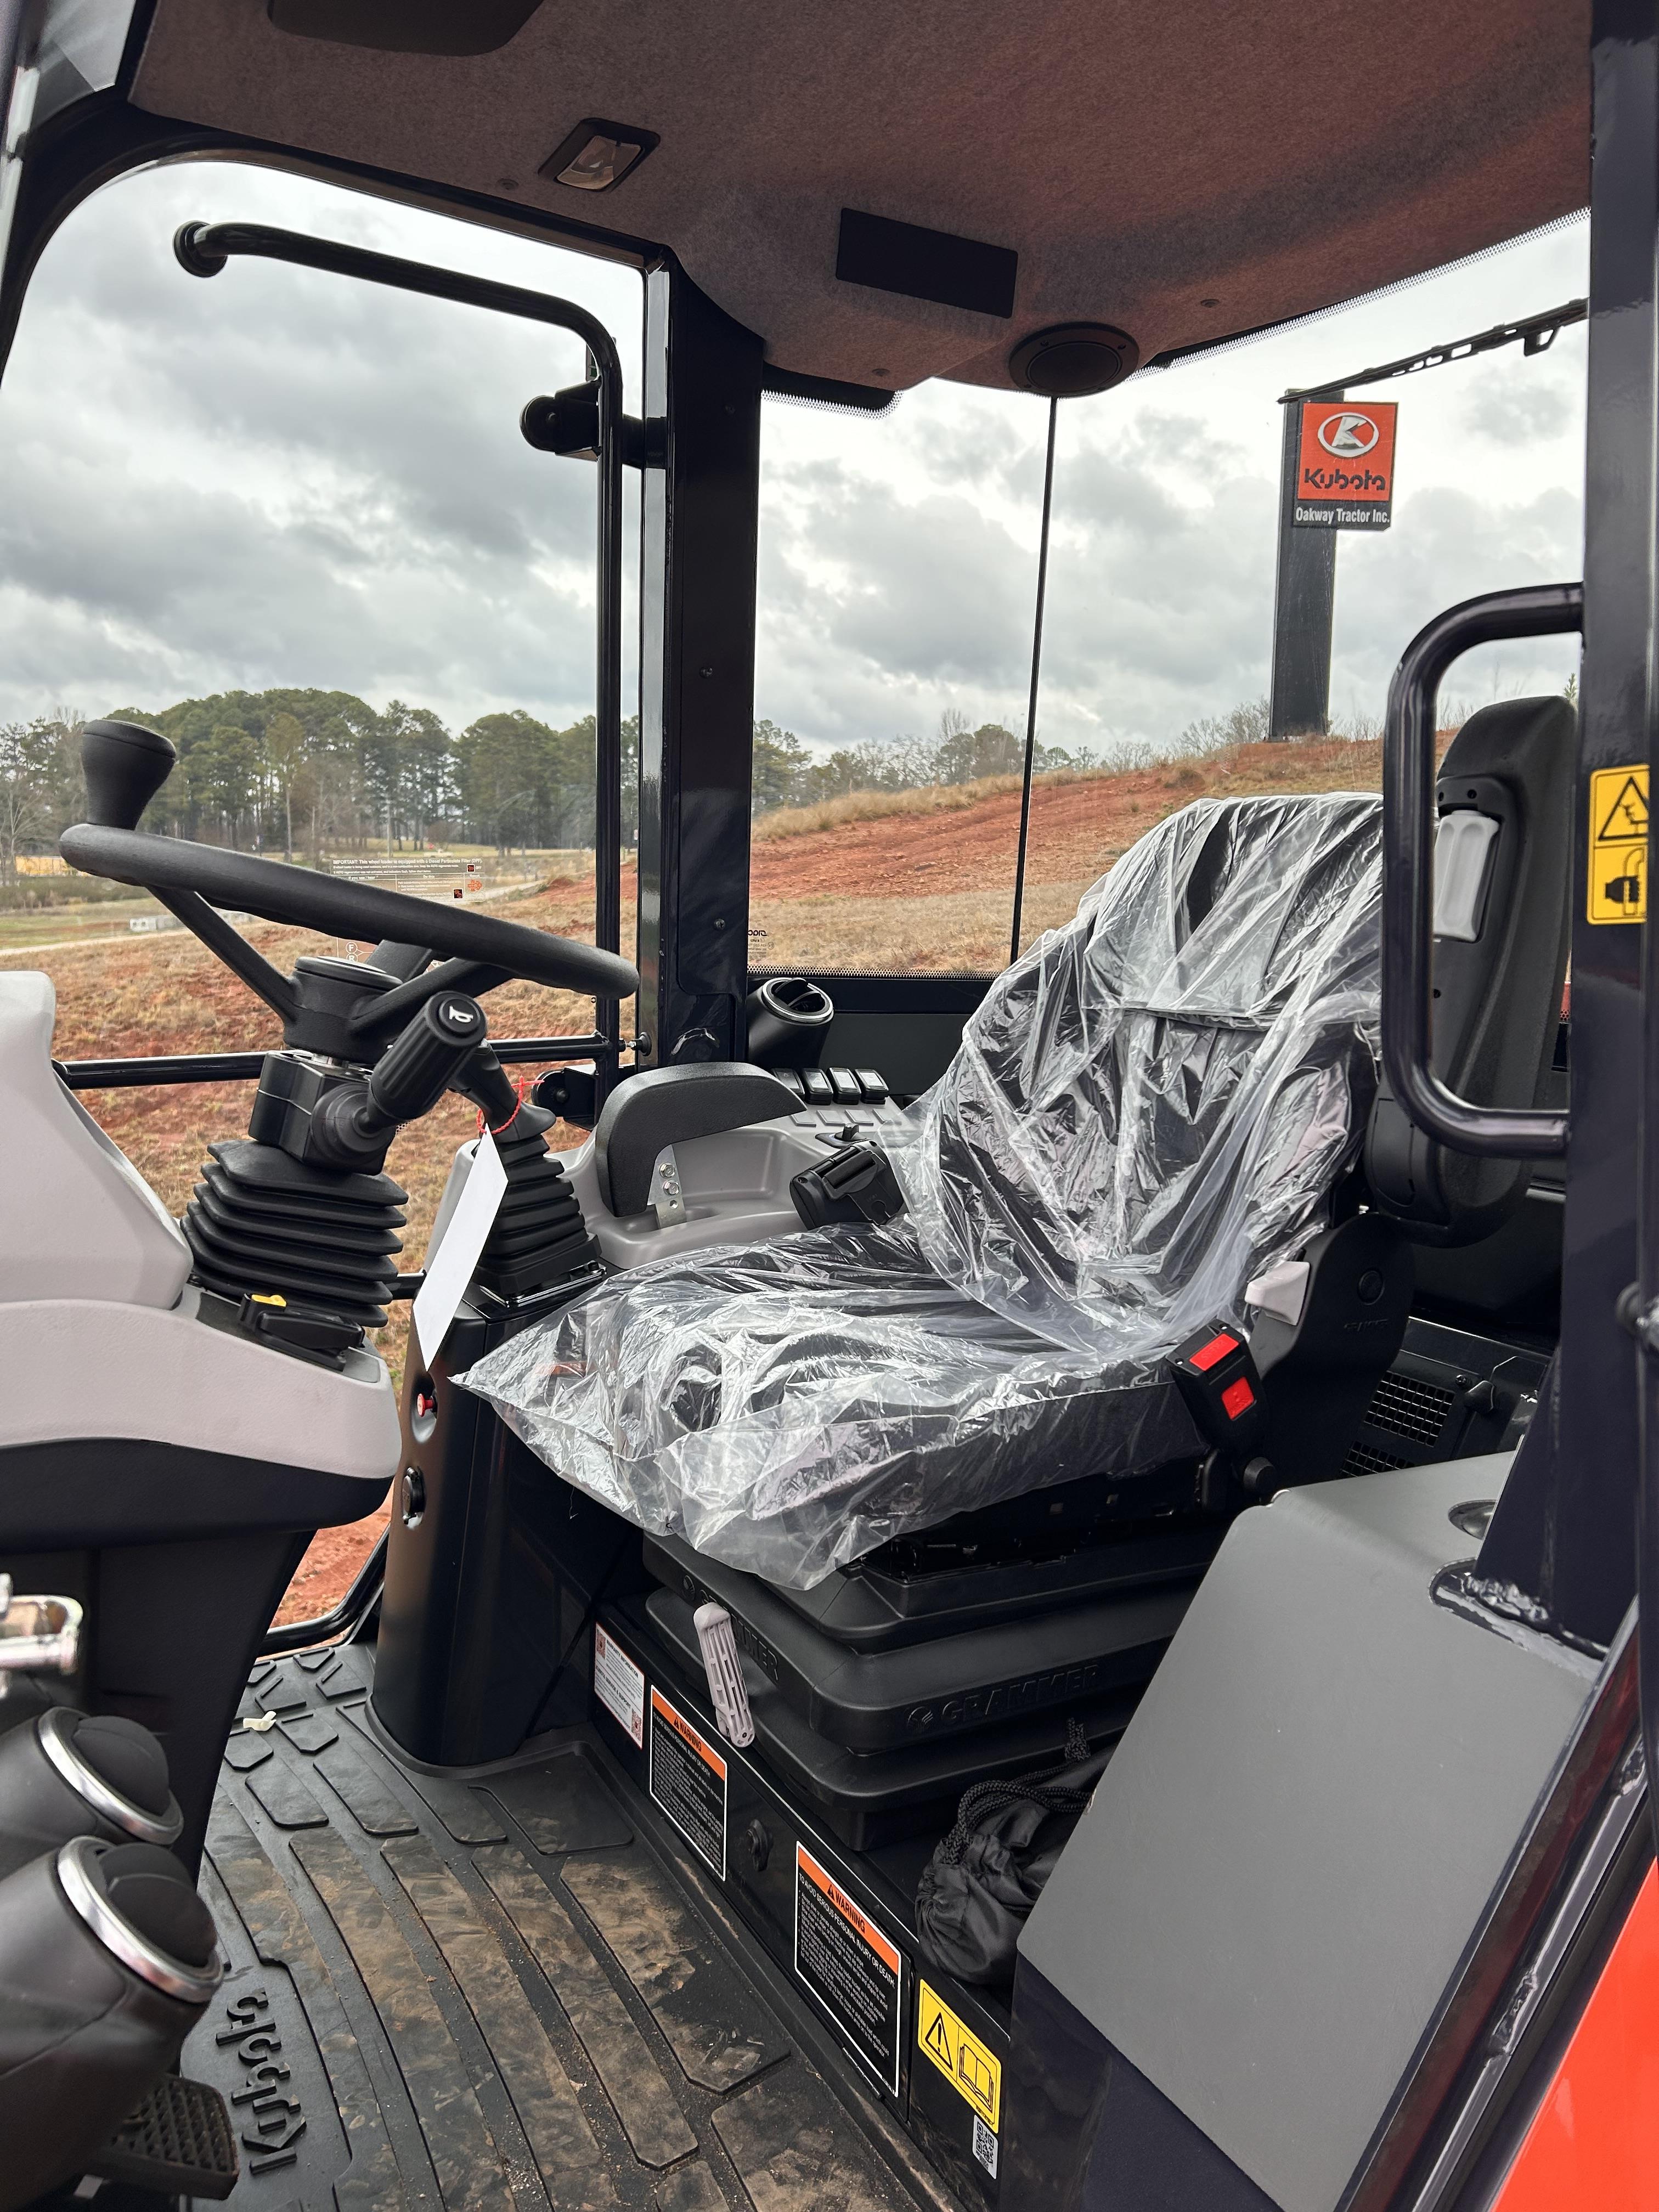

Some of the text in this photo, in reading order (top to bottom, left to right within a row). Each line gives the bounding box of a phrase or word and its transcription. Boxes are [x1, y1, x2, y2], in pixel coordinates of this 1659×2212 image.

[1304, 469, 1386, 490] Kubota
[1295, 507, 1390, 524] Oakway Tractor Inc.
[679, 1719, 702, 1753] WARNING
[799, 1871, 805, 1886] TO
[804, 1878, 816, 1899] AVOID
[816, 1891, 834, 1920] SERIOUS
[834, 1911, 856, 1944] PERSONAL
[856, 1937, 871, 1962] INJURY
[871, 1954, 879, 1971] OR
[835, 1889, 865, 1934] WARNING
[215, 1987, 307, 2175] Kubota
